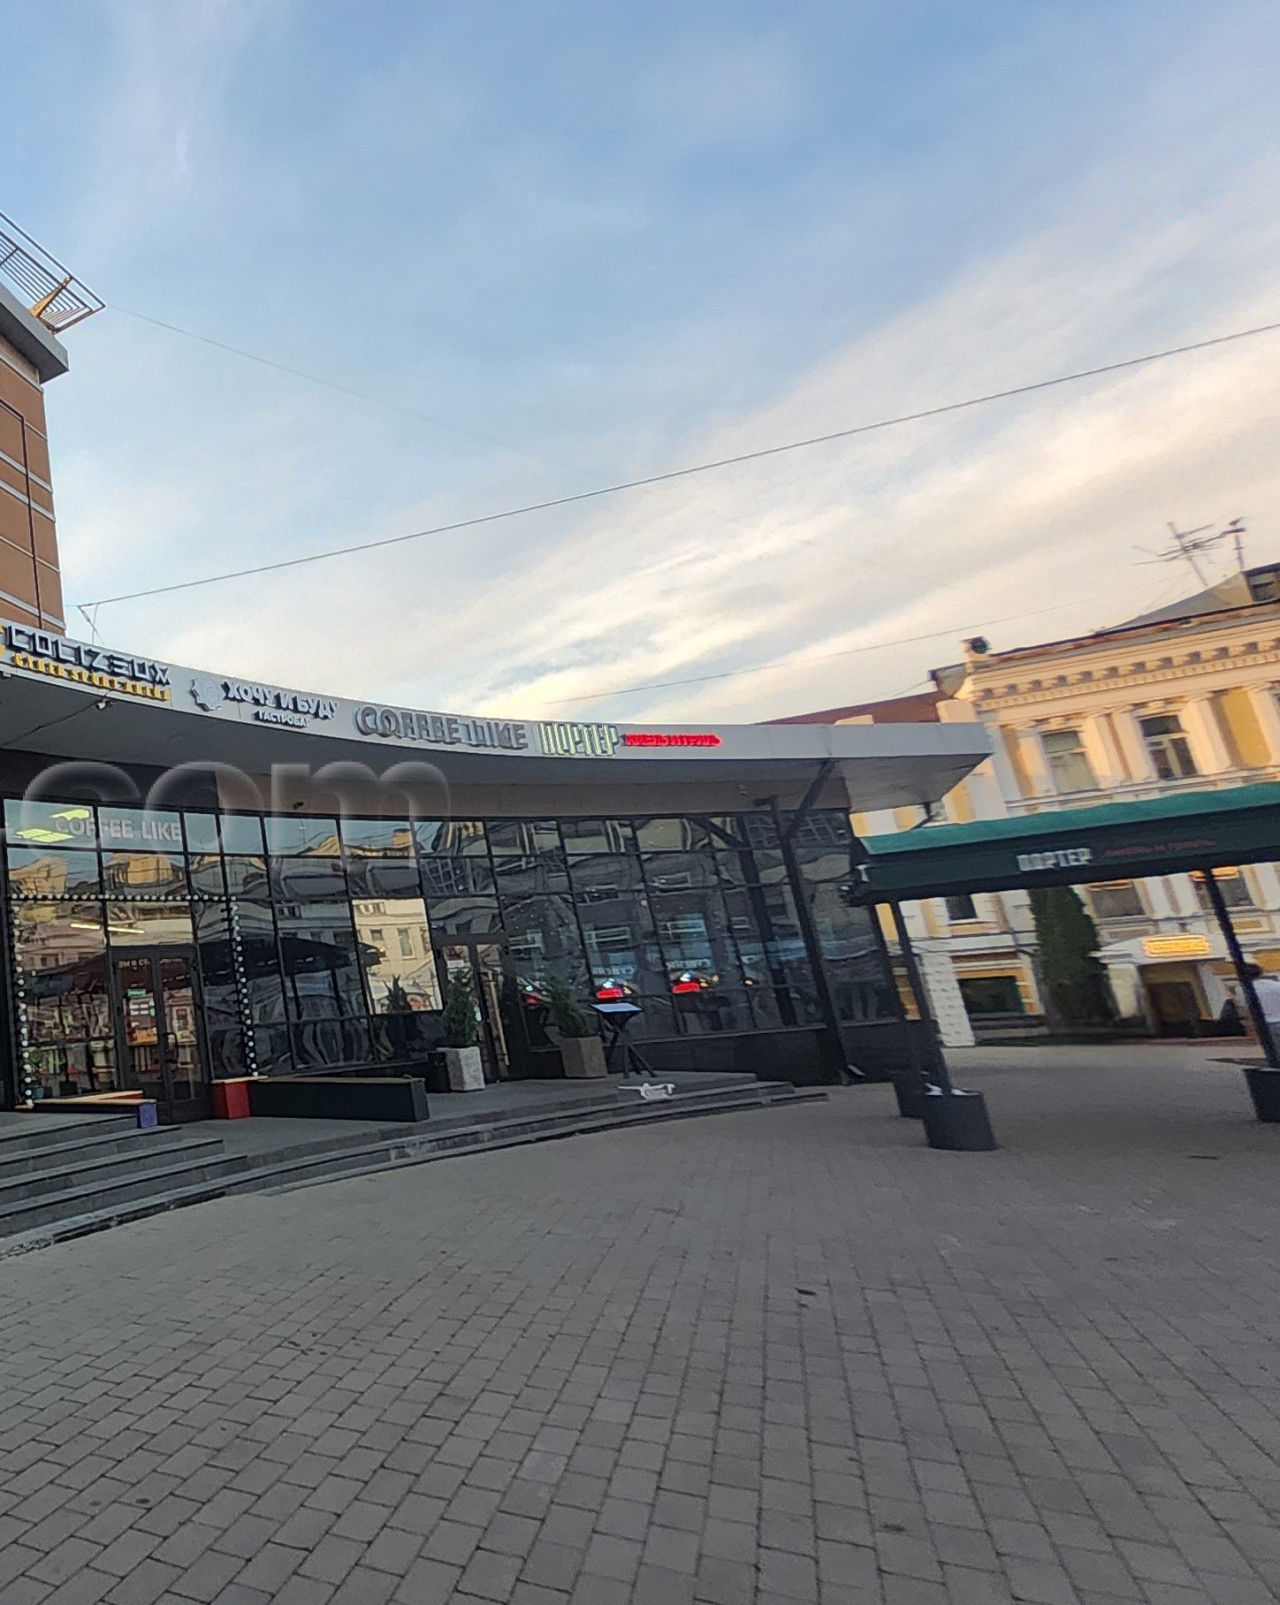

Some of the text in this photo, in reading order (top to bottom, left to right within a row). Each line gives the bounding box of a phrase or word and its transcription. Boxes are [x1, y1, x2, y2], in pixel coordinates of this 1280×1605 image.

[223, 681, 339, 720] ХОЧУ И БУДУ
[254, 710, 311, 728] ГАСТРОБАР
[357, 706, 529, 750] COFFEE LIKE
[538, 722, 617, 757] ПОРТЕР
[54, 815, 183, 842] COFFEE LIKE
